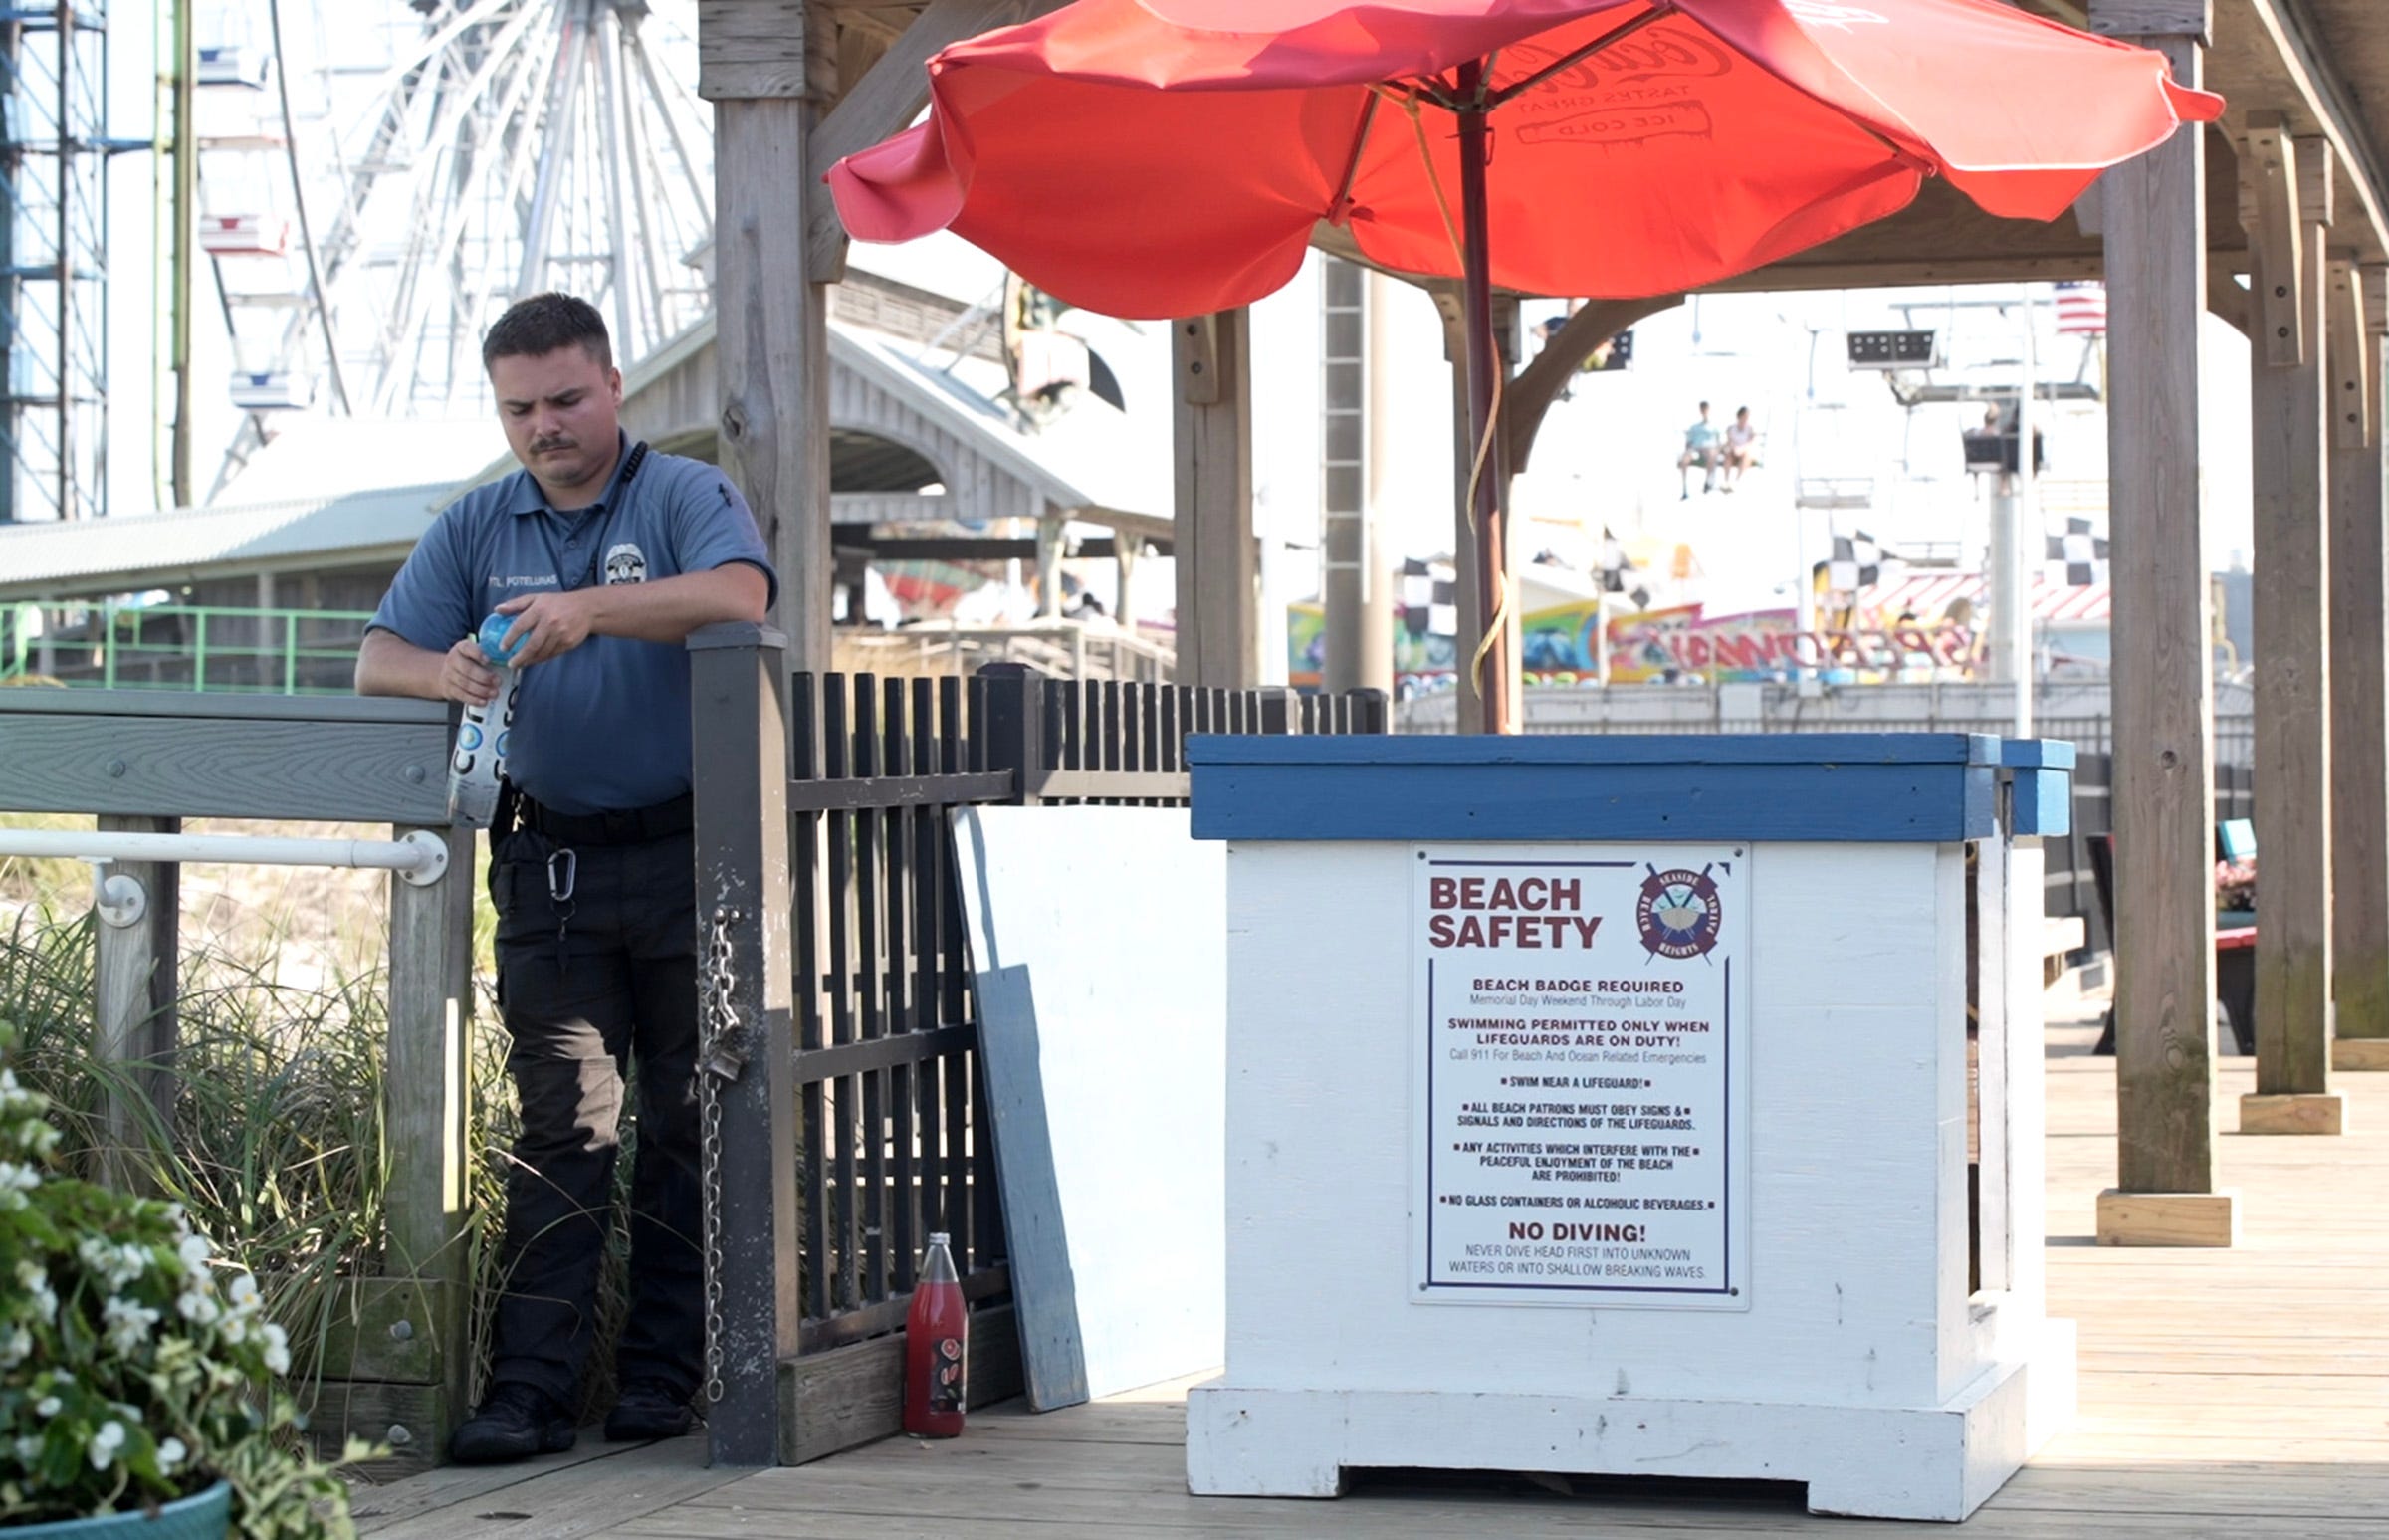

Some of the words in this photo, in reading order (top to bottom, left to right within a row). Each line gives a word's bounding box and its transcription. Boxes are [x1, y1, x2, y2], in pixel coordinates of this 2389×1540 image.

[1429, 877, 1581, 910] BEACH
[1639, 895, 1652, 932] BEACH
[1706, 894, 1719, 935] PATROL
[1429, 915, 1603, 949] SAFETY
[1473, 979, 1529, 991] BEACH
[1535, 980, 1591, 991] BADGE
[1598, 980, 1684, 992] REQUIRED
[1470, 995, 1516, 1005] Memorial
[1520, 995, 1538, 1008] Day
[1543, 996, 1587, 1007] Weekend
[1591, 996, 1631, 1009] Through
[1635, 997, 1664, 1007] Labor
[1667, 997, 1686, 1010] Day
[1448, 1018, 1525, 1030] SWIMMING
[1531, 1019, 1616, 1031] PERMITTED
[1622, 1020, 1659, 1032] ONLY
[1665, 1021, 1709, 1032] WHEN
[1477, 1034, 1569, 1045] LIFEGUARDS
[1576, 1035, 1604, 1046] ARE
[1610, 1035, 1630, 1046] ON
[1635, 1035, 1680, 1047] DUTY!
[1449, 1049, 1468, 1059] Call
[1471, 1049, 1489, 1060] 911
[1493, 1050, 1509, 1060] For
[1512, 1050, 1542, 1061] Beach
[1545, 1050, 1565, 1062] And
[1569, 1051, 1600, 1062] Ocean
[1603, 1051, 1638, 1063] Related
[1643, 1052, 1706, 1065] Emergencies
[1510, 1076, 1539, 1087] SWIM
[1543, 1077, 1569, 1088] NEAR
[1573, 1078, 1579, 1088] A
[1583, 1078, 1642, 1089] LIFEGUARD!
[1471, 1103, 1488, 1113] ALL
[1492, 1103, 1526, 1114] BEACH
[1530, 1104, 1575, 1115] PATRONS
[1579, 1105, 1608, 1115] MUST
[1612, 1105, 1637, 1116] OBEY
[1640, 1106, 1671, 1116] SIGNS
[1674, 1106, 1681, 1116] &
[1458, 1116, 1499, 1127] SIGNALS
[1503, 1117, 1523, 1127] AND
[1527, 1117, 1587, 1128] DIRECTIONS
[1590, 1118, 1602, 1129] OF
[1607, 1118, 1626, 1129] THE
[1629, 1119, 1695, 1130] LIFEGUARDS.
[1463, 1143, 1483, 1153] ANY
[1487, 1143, 1542, 1154] ACTIVITIES
[1546, 1144, 1580, 1154] WHICH
[1583, 1144, 1638, 1155] INTERFERE
[1641, 1145, 1668, 1156] WITH
[1672, 1146, 1690, 1157] THE
[1480, 1156, 1531, 1167] PEACEFUL
[1535, 1158, 1596, 1168] ENJOYMENT
[1600, 1159, 1613, 1169] OF
[1617, 1159, 1635, 1169] THE
[1639, 1159, 1673, 1170] BEACH
[1532, 1171, 1551, 1181] ARE
[1556, 1171, 1620, 1182] PROHIBITED!
[1449, 1195, 1462, 1205] NO
[1465, 1196, 1497, 1206] GLASS
[1500, 1196, 1563, 1208] CONTAINERS
[1567, 1198, 1581, 1208] OR
[1584, 1198, 1639, 1209] ALCOHOLIC
[1643, 1199, 1707, 1210] BEVERAGES.
[1509, 1222, 1543, 1240] NO
[1553, 1223, 1645, 1242] DIVING!
[1465, 1244, 1502, 1256] NEVER
[1505, 1245, 1530, 1257] DIVE
[1534, 1246, 1564, 1258] HEAD
[1568, 1247, 1598, 1259] FIRST
[1603, 1248, 1628, 1259] INTO
[1631, 1248, 1690, 1260] UNKNOWN
[1449, 1261, 1494, 1272] WATERS
[1498, 1262, 1513, 1273] OR
[1517, 1263, 1543, 1274] INTO
[1547, 1264, 1602, 1275] SHALLOW
[1606, 1265, 1661, 1277] BREAKING
[1664, 1267, 1705, 1278] WAVES.
